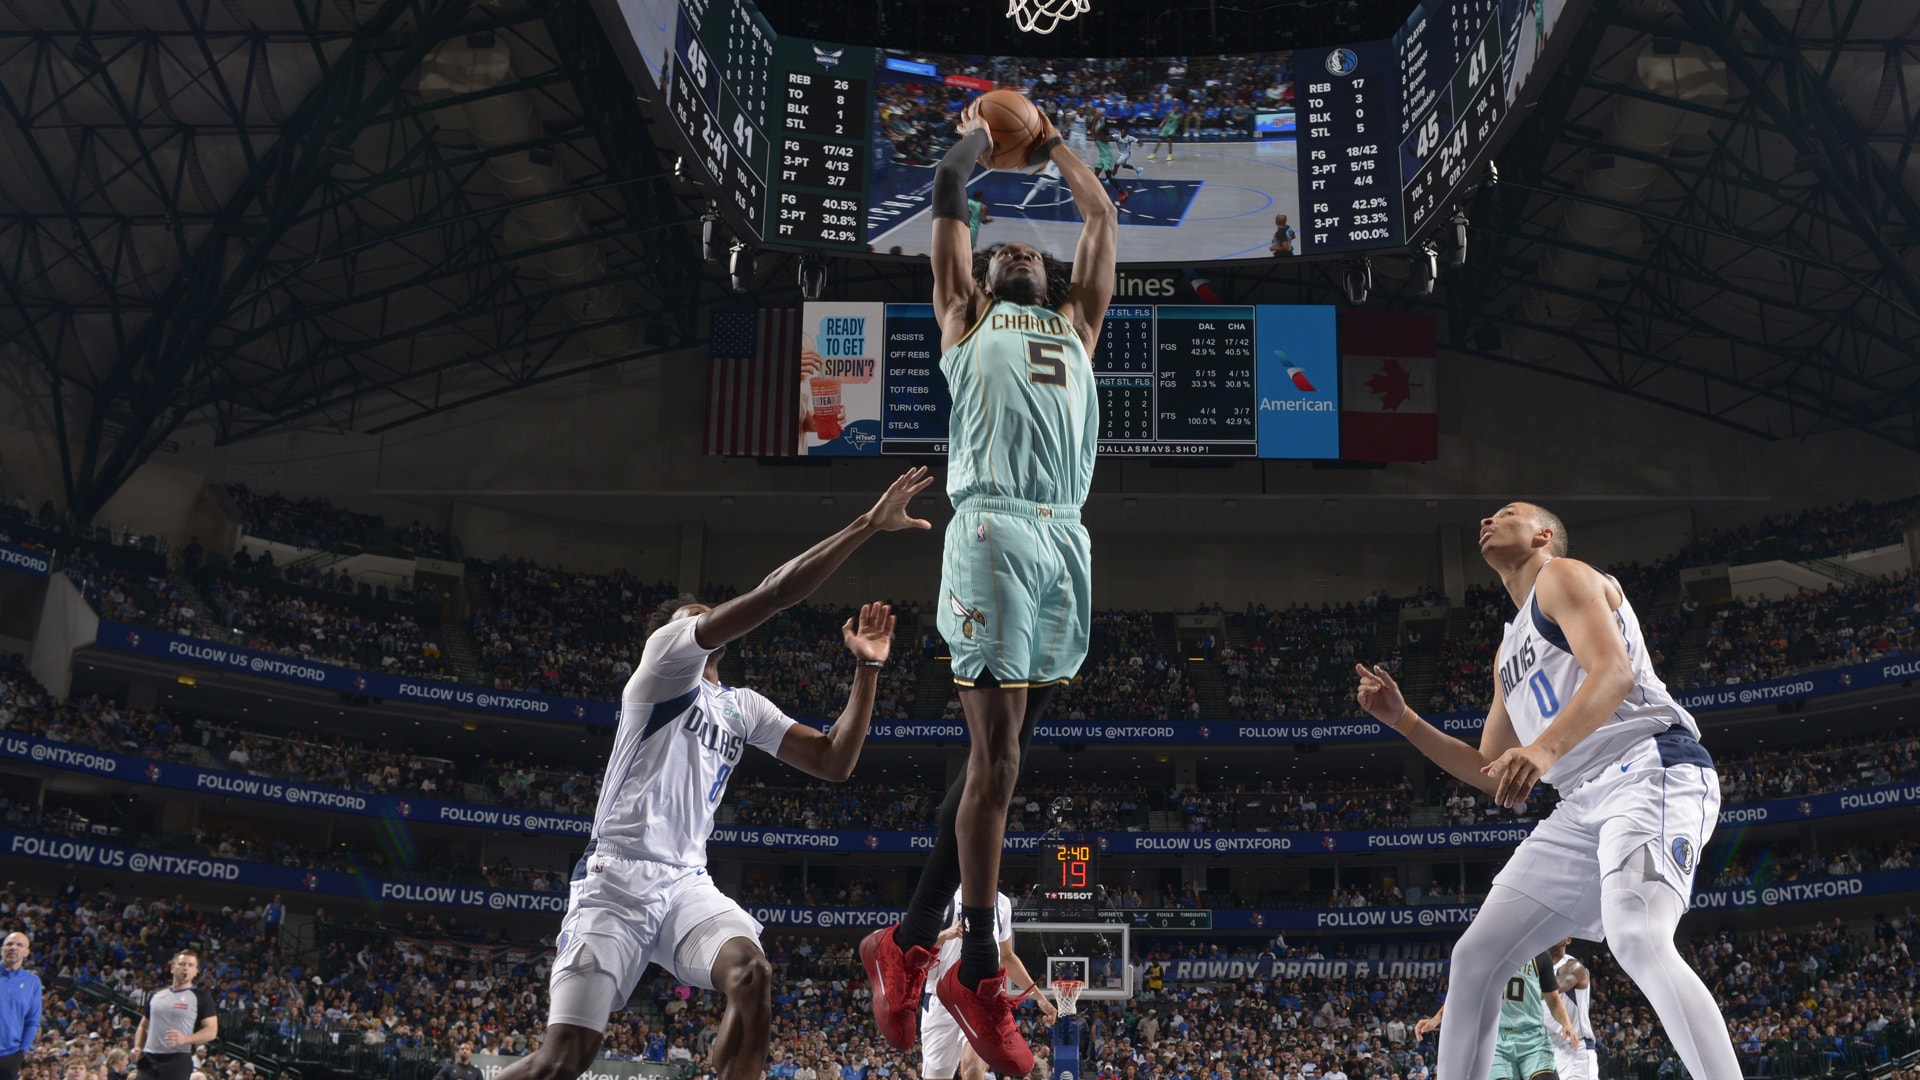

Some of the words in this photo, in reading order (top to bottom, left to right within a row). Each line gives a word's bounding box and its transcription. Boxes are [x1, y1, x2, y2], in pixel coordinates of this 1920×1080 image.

[1406, 18, 1427, 48] PLAYER
[687, 38, 708, 89] 45
[1468, 38, 1487, 89] 41
[789, 73, 811, 85] REB
[834, 80, 849, 91] 26
[1309, 82, 1331, 94] REB
[1351, 78, 1365, 89] 17
[1409, 68, 1427, 92] Brown
[788, 89, 804, 99] TO
[836, 95, 845, 105] 8
[1308, 98, 1324, 109] TO
[1355, 94, 1363, 104] 3
[1410, 85, 1426, 108] Irving
[787, 103, 809, 115] BLK
[836, 110, 843, 119] 1
[1309, 112, 1331, 124] BLK
[1356, 108, 1364, 119] 0
[786, 118, 806, 130] STL
[835, 124, 844, 134] 2
[1310, 127, 1331, 138] STL
[1356, 123, 1365, 133] 5
[702, 113, 728, 170] 2:41
[732, 113, 753, 159] 41
[1416, 111, 1440, 159] 45
[784, 140, 800, 151] FG
[822, 145, 854, 157] 17/42
[1311, 150, 1326, 161] FG
[1346, 144, 1378, 157] 18/42
[1440, 119, 1468, 178] 2:41
[783, 156, 810, 168] 3-PT
[824, 160, 850, 172] 4/13
[1311, 164, 1337, 175] 3-PT
[1350, 160, 1375, 172] 5/15
[736, 167, 748, 189] TOL
[750, 184, 756, 198] 4
[782, 171, 797, 181] FT
[827, 175, 846, 186] 3/7
[1312, 180, 1326, 190] FT
[1354, 175, 1373, 186] 4/4
[1411, 183, 1423, 203] TOL
[1427, 171, 1433, 185] 5
[735, 190, 746, 210] FLS
[749, 206, 755, 220] 0
[781, 194, 797, 205] FG
[822, 199, 858, 212] 40.5%
[1313, 203, 1329, 214] FG
[1352, 197, 1387, 210] 42.9%
[1413, 205, 1425, 225] FLS
[1428, 195, 1434, 209] 3
[780, 209, 806, 221] 3-PT
[822, 214, 857, 227] 30.8%
[1314, 217, 1340, 229] 3-PT
[1353, 212, 1388, 225] 33.3%
[779, 225, 794, 235] FT
[820, 229, 856, 242] 42.9%
[1314, 233, 1328, 244] FT
[1348, 227, 1389, 241] 100.0%
[1112, 272, 1175, 296] lines
[826, 318, 865, 336] READY
[992, 313, 1070, 336] CHARLO
[890, 333, 924, 341] ASSISTS
[826, 338, 841, 355] TO
[843, 338, 864, 356] GET
[890, 351, 906, 359] OFF
[908, 351, 930, 359] REBS
[1161, 343, 1177, 351] FGS
[825, 359, 874, 377] SIPPIN'?
[1027, 340, 1067, 389] 5
[889, 386, 905, 394] TOT
[906, 386, 929, 394] REBS
[1100, 378, 1115, 386] AST
[1117, 378, 1131, 386] STL
[1135, 378, 1150, 386] FLS
[1160, 380, 1177, 388] FGS
[820, 397, 832, 405] TEA
[889, 404, 911, 412] TURN
[913, 404, 936, 412] OVRS
[888, 421, 919, 429] STEALS
[1098, 445, 1210, 454] DALLASMAVS.SHOP!
[0, 549, 48, 572] TXFORD
[169, 641, 227, 663] FOLLOW
[229, 653, 248, 667] US
[250, 656, 325, 682] @NTXFORD
[1499, 634, 1536, 705] ALLAS
[400, 684, 453, 700] FOLLOW
[456, 690, 474, 703] US
[477, 693, 549, 713] @NTXFORD
[1529, 668, 1560, 719] 0
[1718, 692, 1736, 703] US
[1739, 681, 1814, 702] @NTXFORD
[876, 726, 891, 736] US
[894, 725, 963, 738] @NTXFORD
[1033, 727, 1082, 737] FOLLOW
[1085, 727, 1102, 737] US
[1105, 727, 1174, 738] @NTXFORD
[1239, 727, 1288, 738] FOLLOW
[1292, 727, 1308, 737] US
[1311, 724, 1380, 739] @NTXFORD
[7, 740, 28, 755] US
[31, 741, 116, 772] @NTXFORD
[197, 774, 259, 794] FOLLOW
[262, 784, 282, 798] US
[285, 786, 366, 810] @NTXFORD
[709, 763, 731, 804] 8
[1841, 789, 1900, 809] FOLLOW
[440, 807, 499, 824] FOLLOW
[502, 814, 520, 826] US
[524, 815, 592, 833] @NTXFOR
[741, 831, 759, 842] US
[762, 832, 838, 847] @NTXFORD
[1135, 837, 1189, 849] FOLLOW
[1194, 837, 1211, 849] US
[1215, 837, 1291, 851] @NTXFORD
[1368, 834, 1424, 847] FOLLOW
[1427, 833, 1446, 845] US
[12, 835, 94, 862] FOLLOW
[99, 850, 125, 867] US
[129, 853, 240, 880] @NTXFORD
[1058, 847, 1089, 861] 2:40
[1062, 861, 1086, 887] 19
[382, 883, 455, 903] FOLLOW
[460, 890, 484, 905] US
[1058, 892, 1093, 900] TISSOT
[1732, 890, 1757, 905] US
[1762, 878, 1863, 905] @NTXFORD
[791, 910, 813, 924] US
[817, 911, 907, 926] @NTXFOR
[1162, 919, 1168, 927] 0
[1189, 919, 1196, 927] 4
[1317, 912, 1383, 927] FOLLOW
[1391, 911, 1413, 926] US
[1177, 962, 1260, 979] ROWDY
[1271, 961, 1349, 979] PROUD
[1355, 961, 1371, 978] &
[1377, 961, 1443, 979] LOUD!
